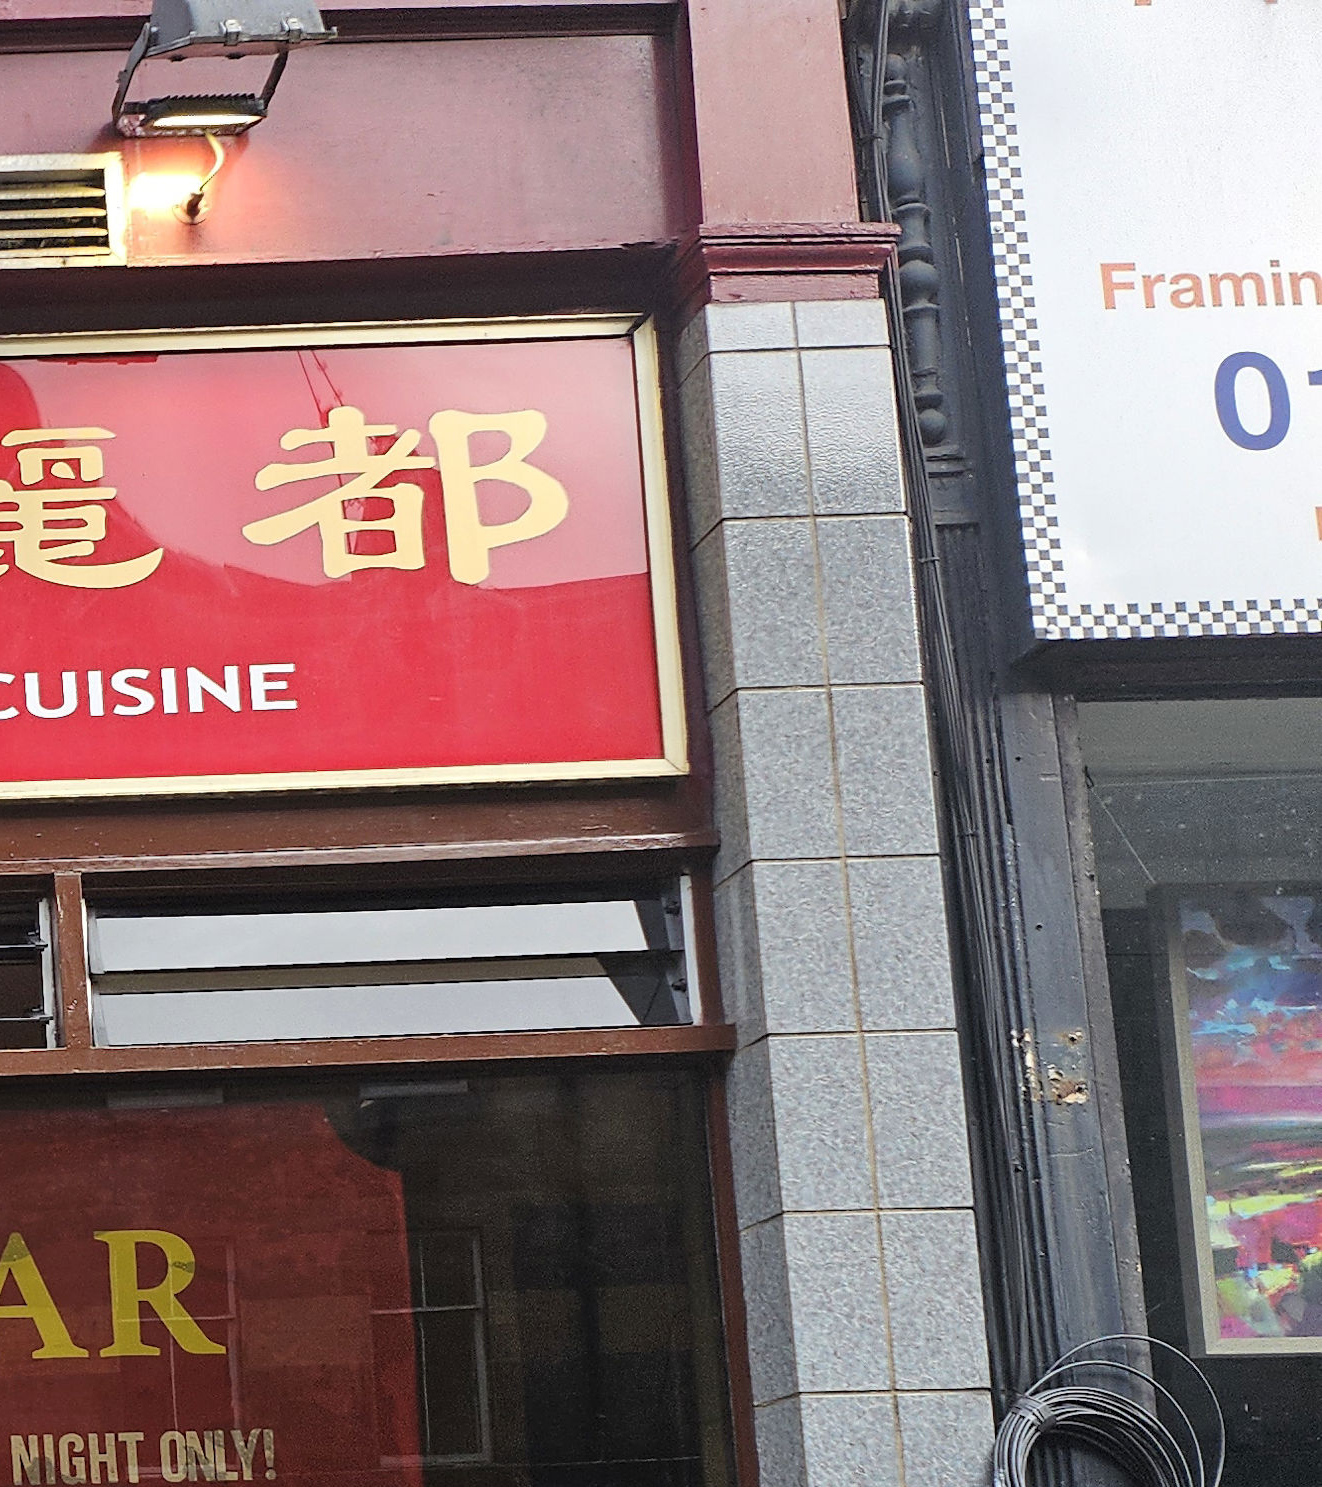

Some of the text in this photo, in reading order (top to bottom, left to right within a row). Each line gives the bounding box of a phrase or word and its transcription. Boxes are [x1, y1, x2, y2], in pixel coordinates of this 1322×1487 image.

[1100, 259, 1322, 310] Framin
[10, 1430, 145, 1487] NIGHT
[160, 1428, 277, 1483] ONLY!
